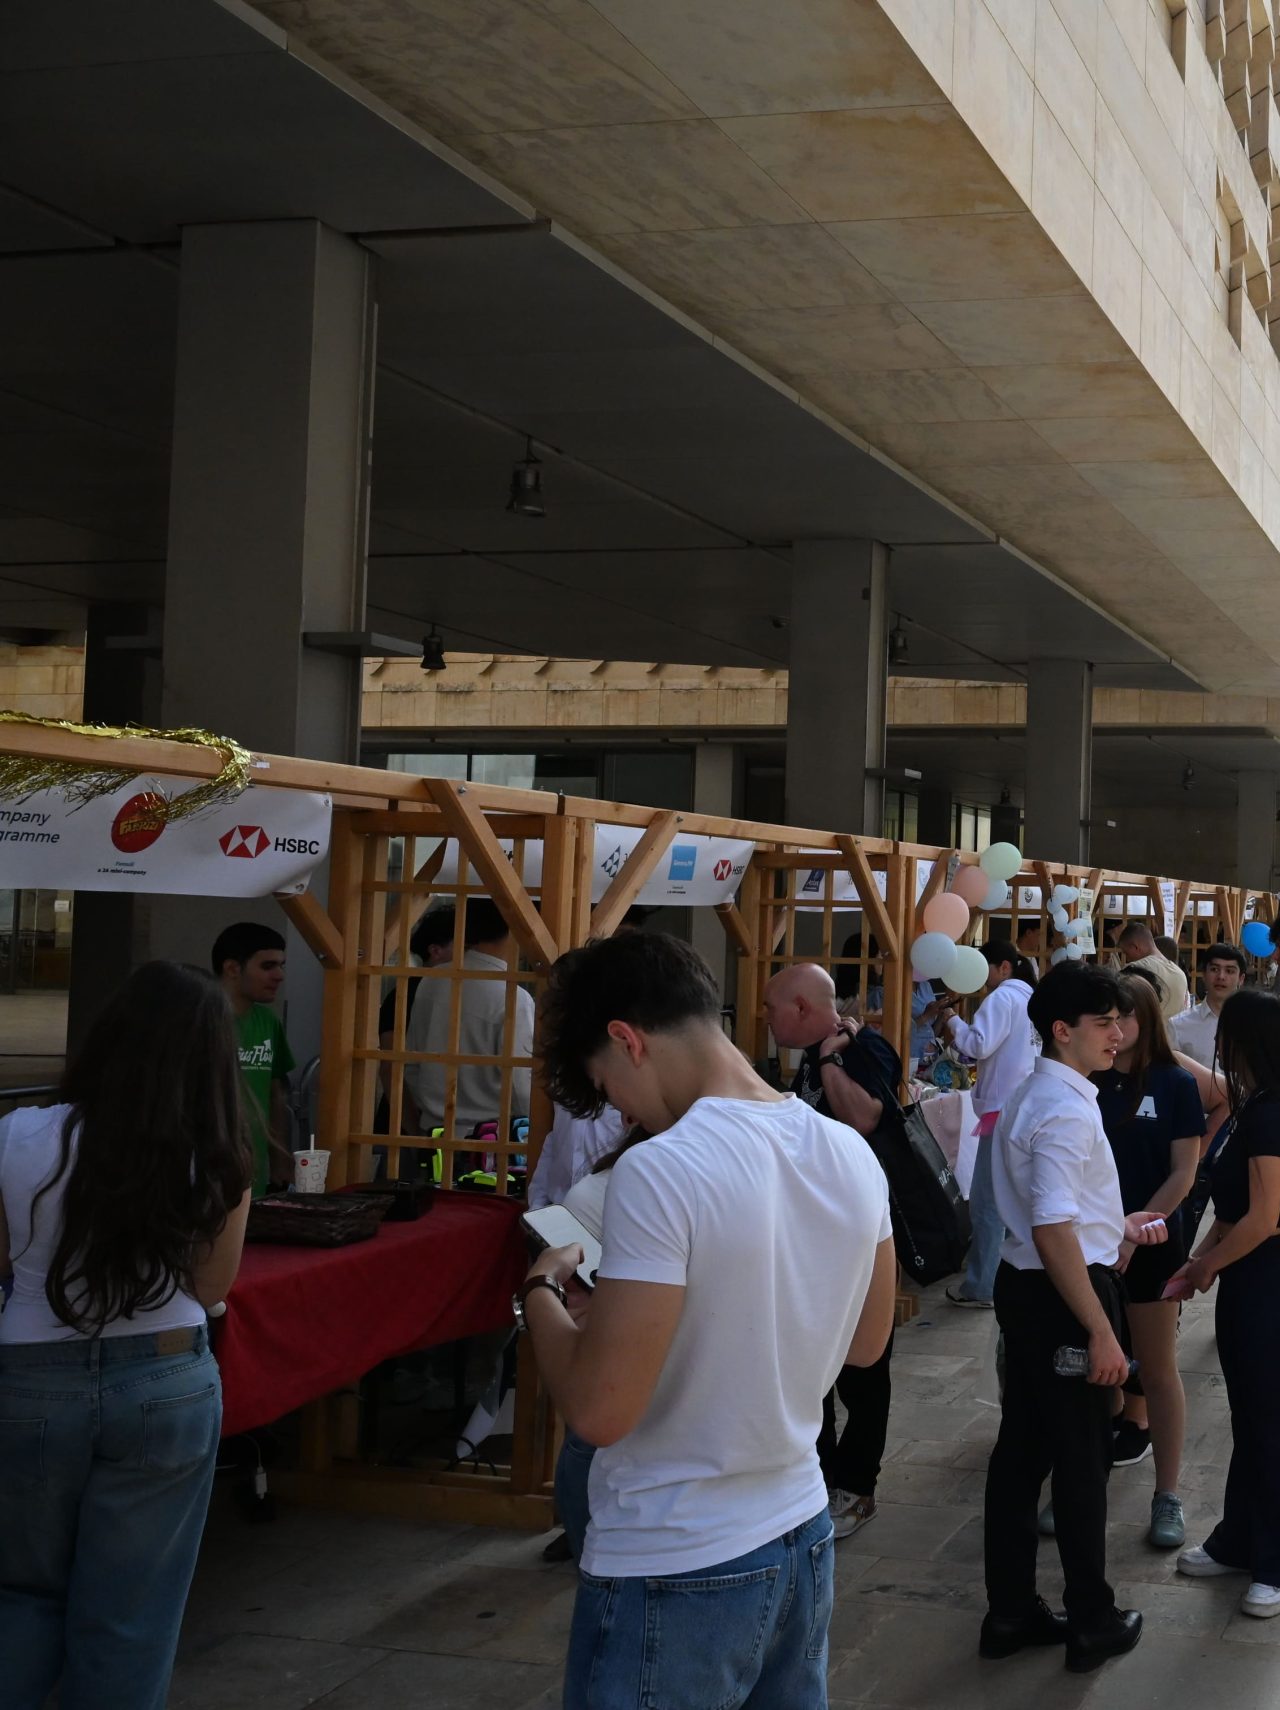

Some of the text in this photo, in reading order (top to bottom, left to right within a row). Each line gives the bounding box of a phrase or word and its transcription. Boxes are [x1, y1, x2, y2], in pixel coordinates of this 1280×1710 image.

[0, 810, 51, 826] mpany
[274, 837, 320, 855] HSBC
[1135, 1095, 1158, 1118] A
